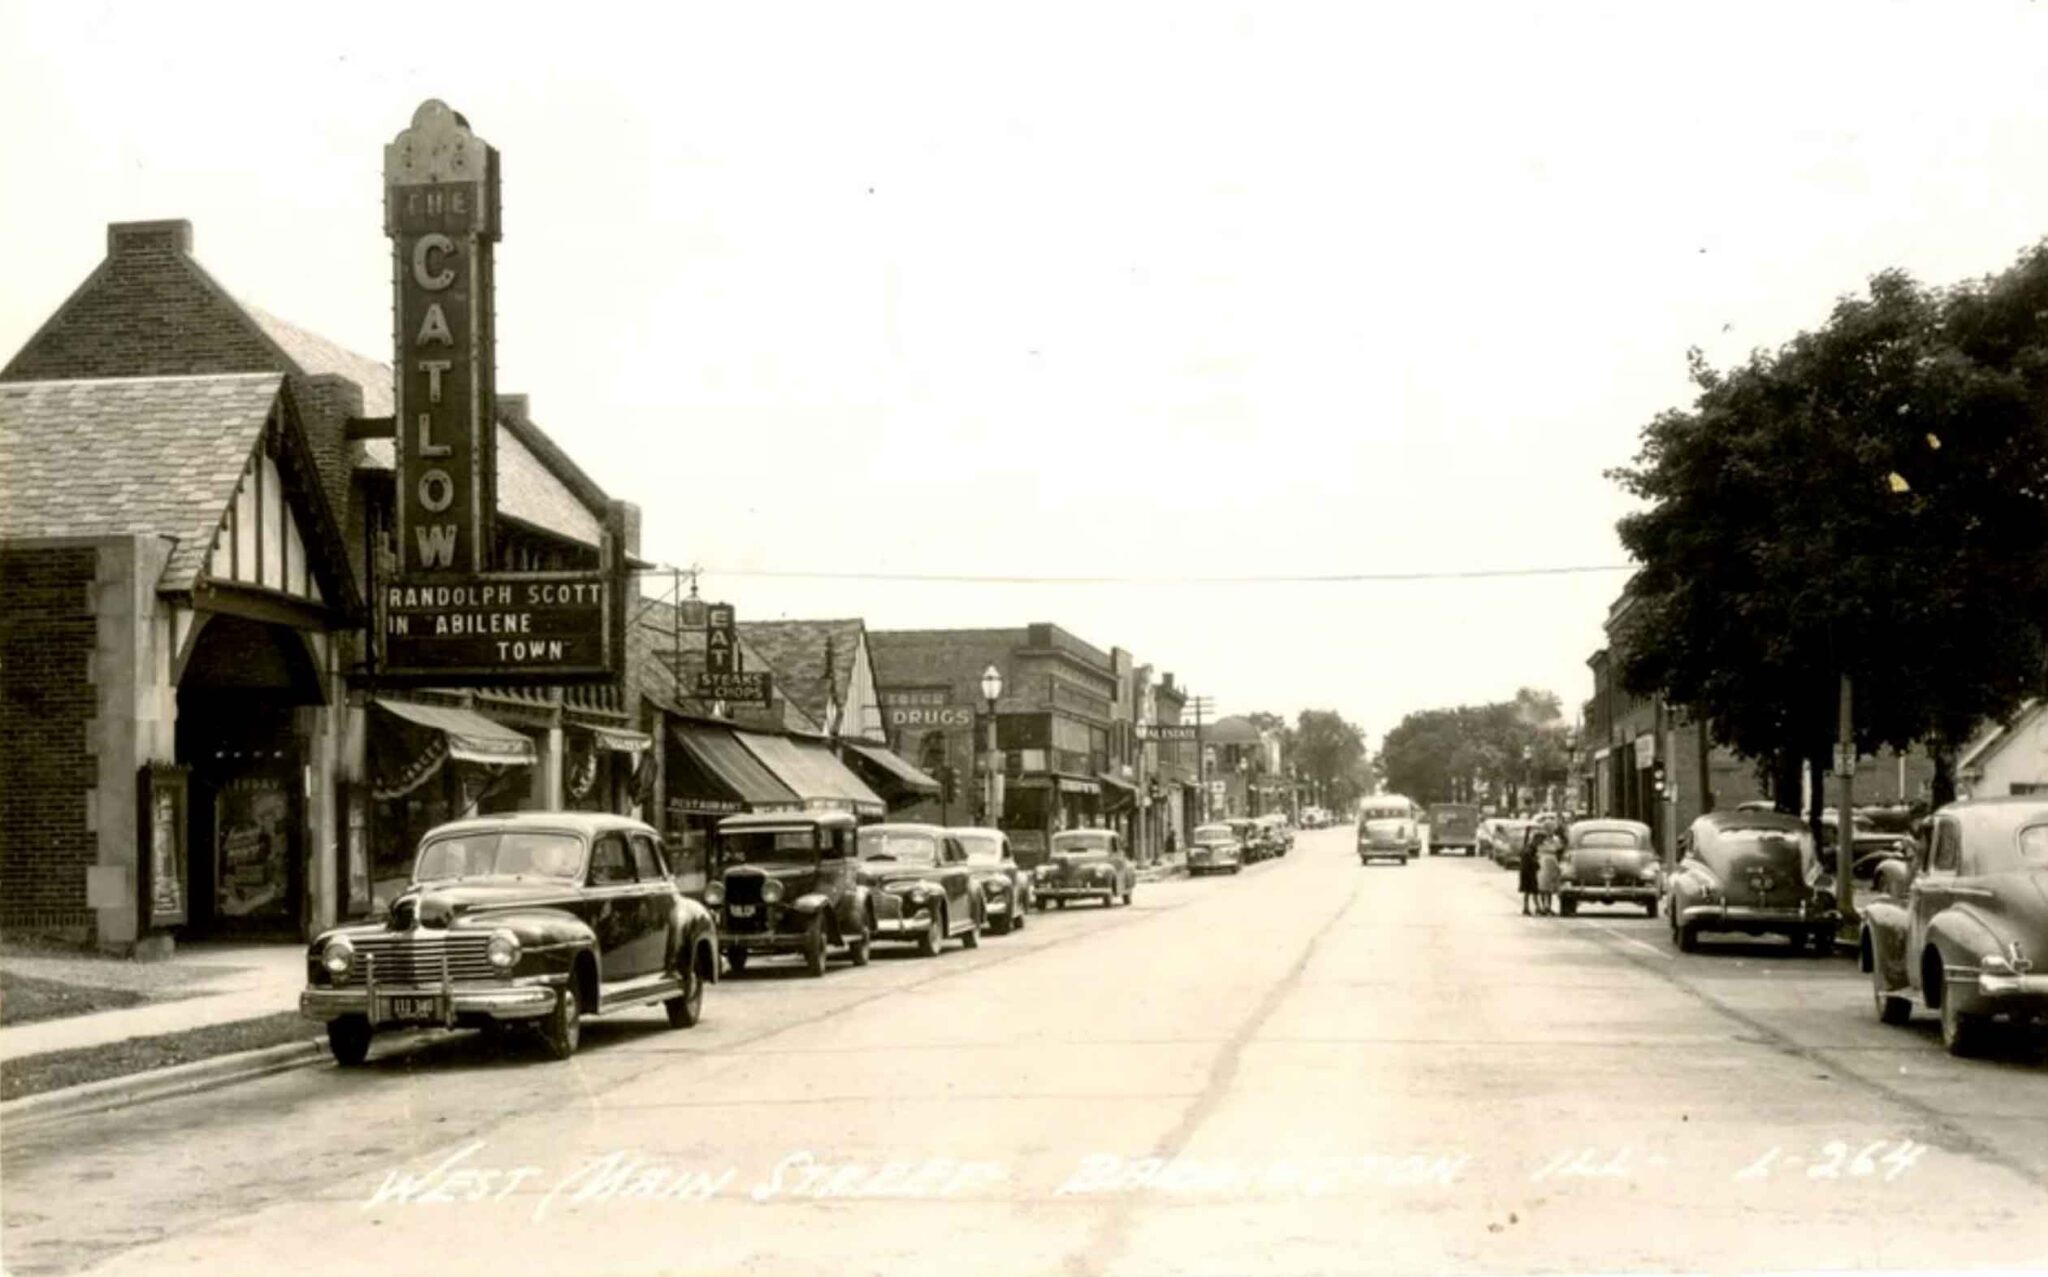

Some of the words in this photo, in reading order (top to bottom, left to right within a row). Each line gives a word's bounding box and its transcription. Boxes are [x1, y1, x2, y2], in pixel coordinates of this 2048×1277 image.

[408, 193, 469, 216] THE
[412, 232, 458, 568] CATLOW
[389, 586, 512, 607] RANDOLPH
[527, 584, 600, 604] SCOTT
[389, 616, 409, 634] IN
[436, 613, 532, 635] ABILENE
[710, 610, 729, 667] EAT
[496, 641, 563, 661] TOWN
[702, 674, 763, 686] STEAKS
[892, 709, 971, 726] DRUGS
